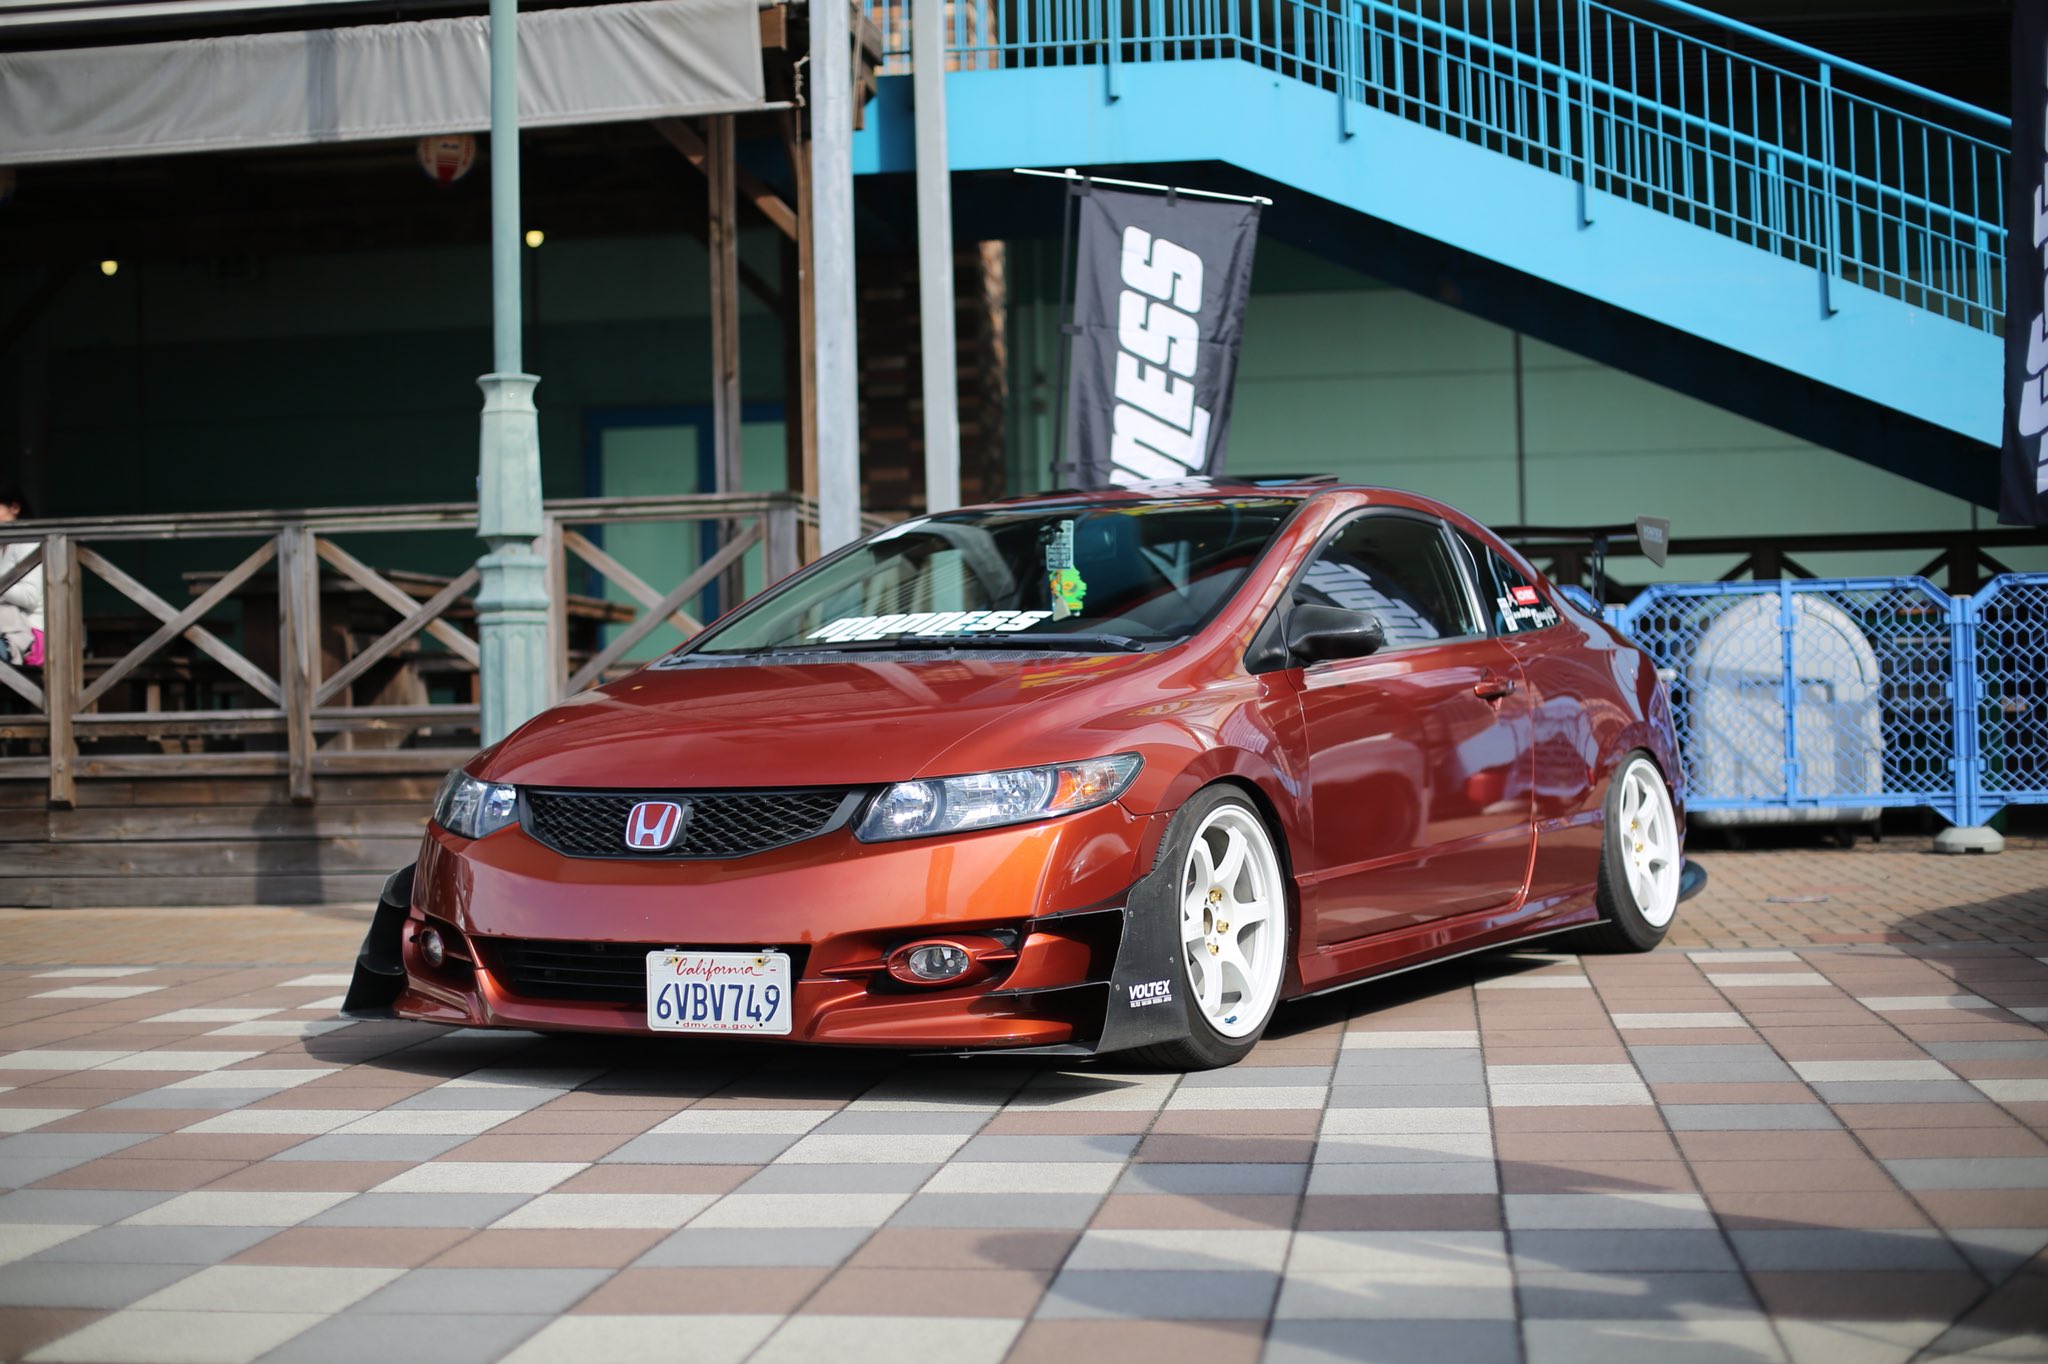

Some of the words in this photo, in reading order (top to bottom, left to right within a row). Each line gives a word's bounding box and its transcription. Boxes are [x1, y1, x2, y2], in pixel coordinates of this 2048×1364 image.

[1109, 225, 1211, 485] NESS
[805, 610, 1054, 642] MADNESS
[676, 957, 764, 982] California
[656, 983, 781, 1022] 6VBV749
[1128, 979, 1171, 1000] VOLTEX
[682, 1021, 755, 1030] dmv.ca.gov
